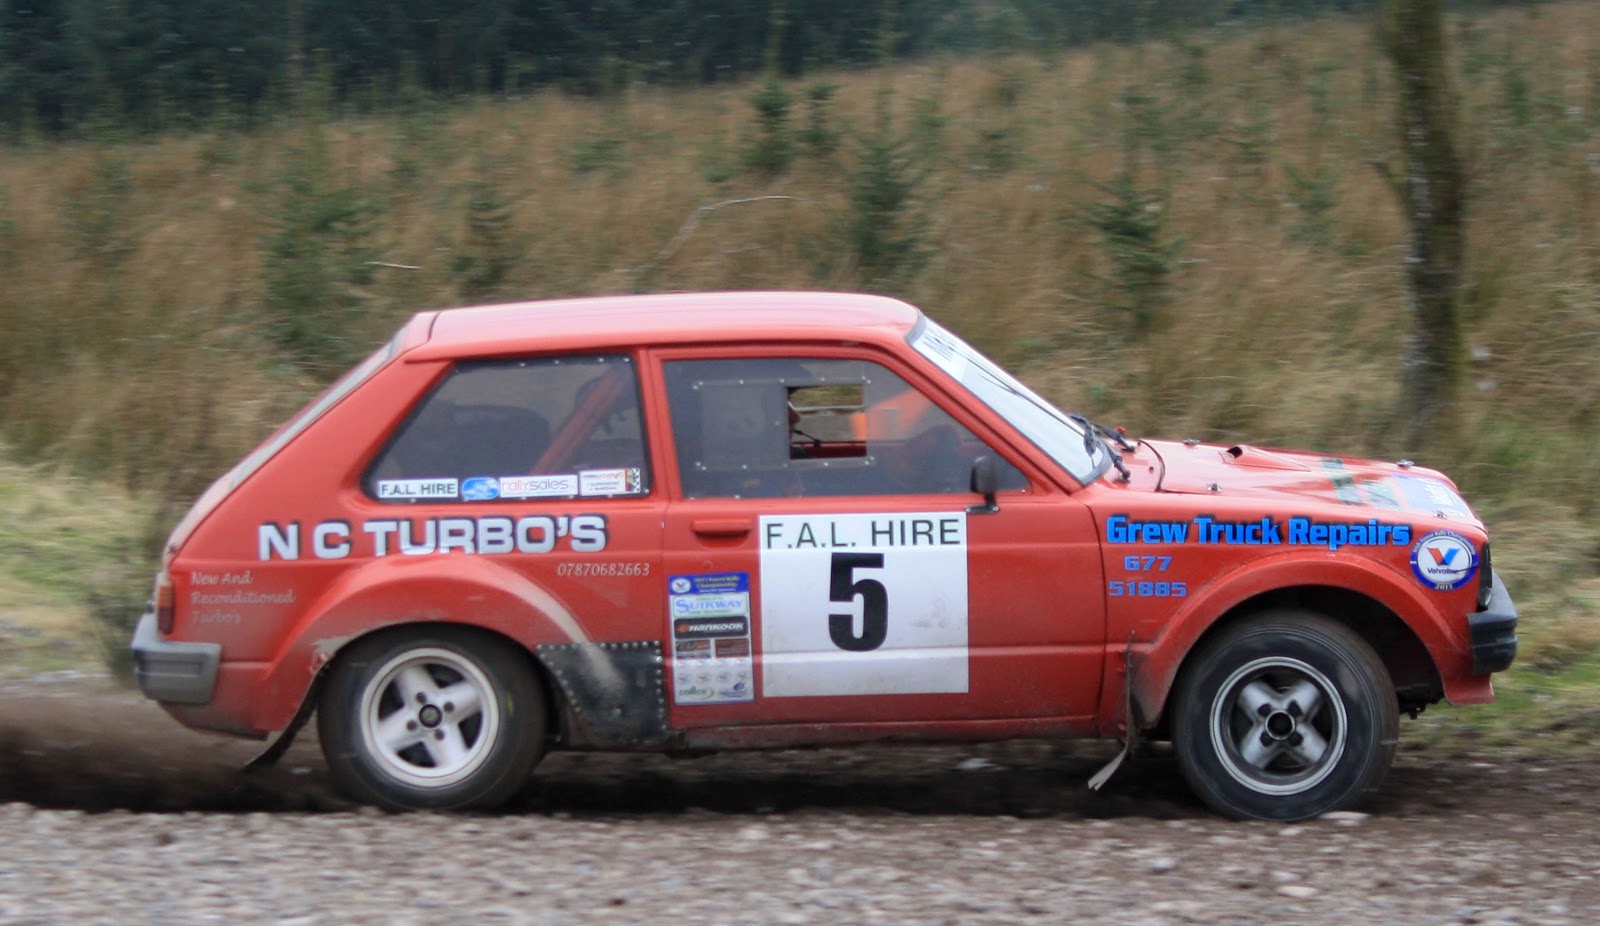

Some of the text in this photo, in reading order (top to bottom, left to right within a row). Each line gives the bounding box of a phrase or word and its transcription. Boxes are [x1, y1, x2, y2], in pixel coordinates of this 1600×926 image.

[380, 483, 456, 496] F.A.L. HIRE
[257, 514, 608, 561] N C TURBO'S
[766, 518, 961, 549] F.A.L. HIRE
[1106, 514, 1411, 551] Grew Truck Repairs
[556, 562, 650, 576] 07870682663
[1124, 556, 1172, 571] 677
[191, 570, 254, 585] New And
[191, 588, 297, 604] Reconditioned
[1109, 581, 1187, 597] 51885
[828, 552, 888, 652] 5
